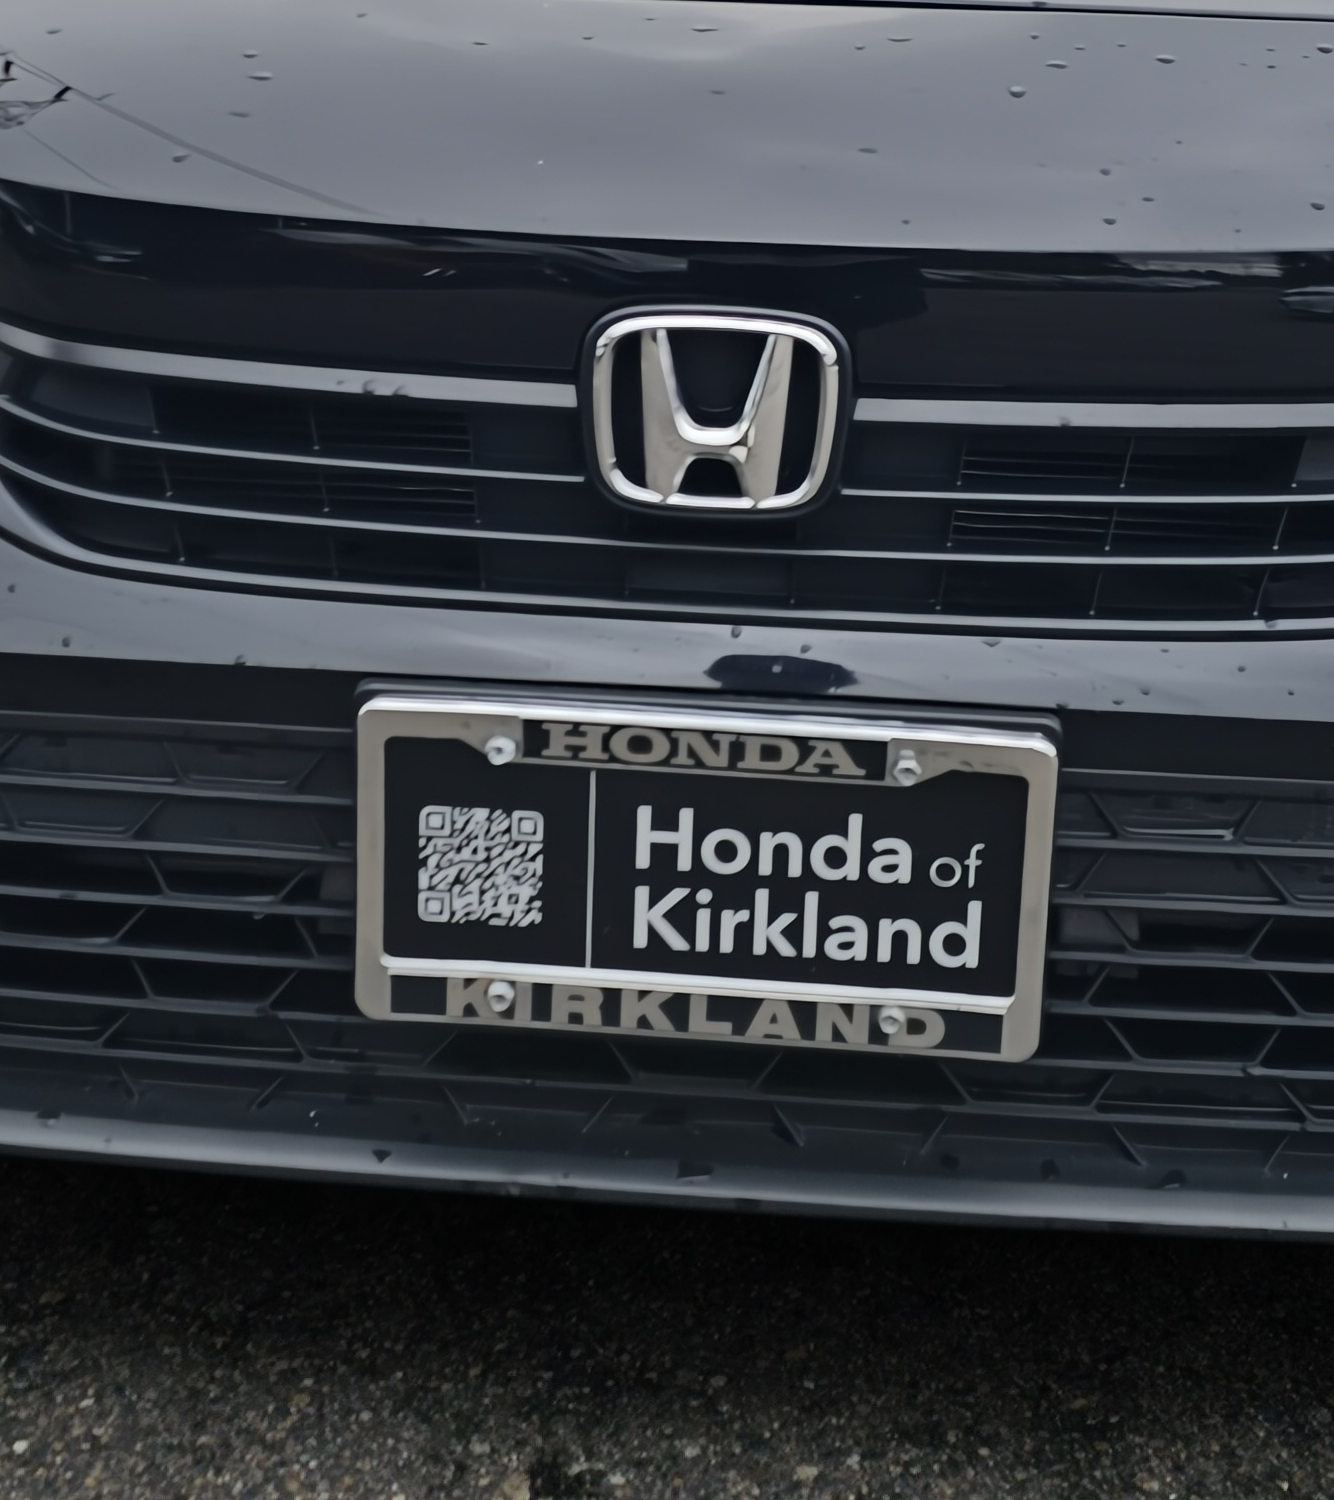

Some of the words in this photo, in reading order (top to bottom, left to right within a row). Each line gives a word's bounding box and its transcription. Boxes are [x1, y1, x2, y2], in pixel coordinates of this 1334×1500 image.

[540, 723, 866, 776] HONDA
[634, 804, 913, 884] Honda
[929, 843, 985, 888] of
[632, 885, 983, 969] Kirkland
[445, 976, 946, 1048] KIRKLAND
